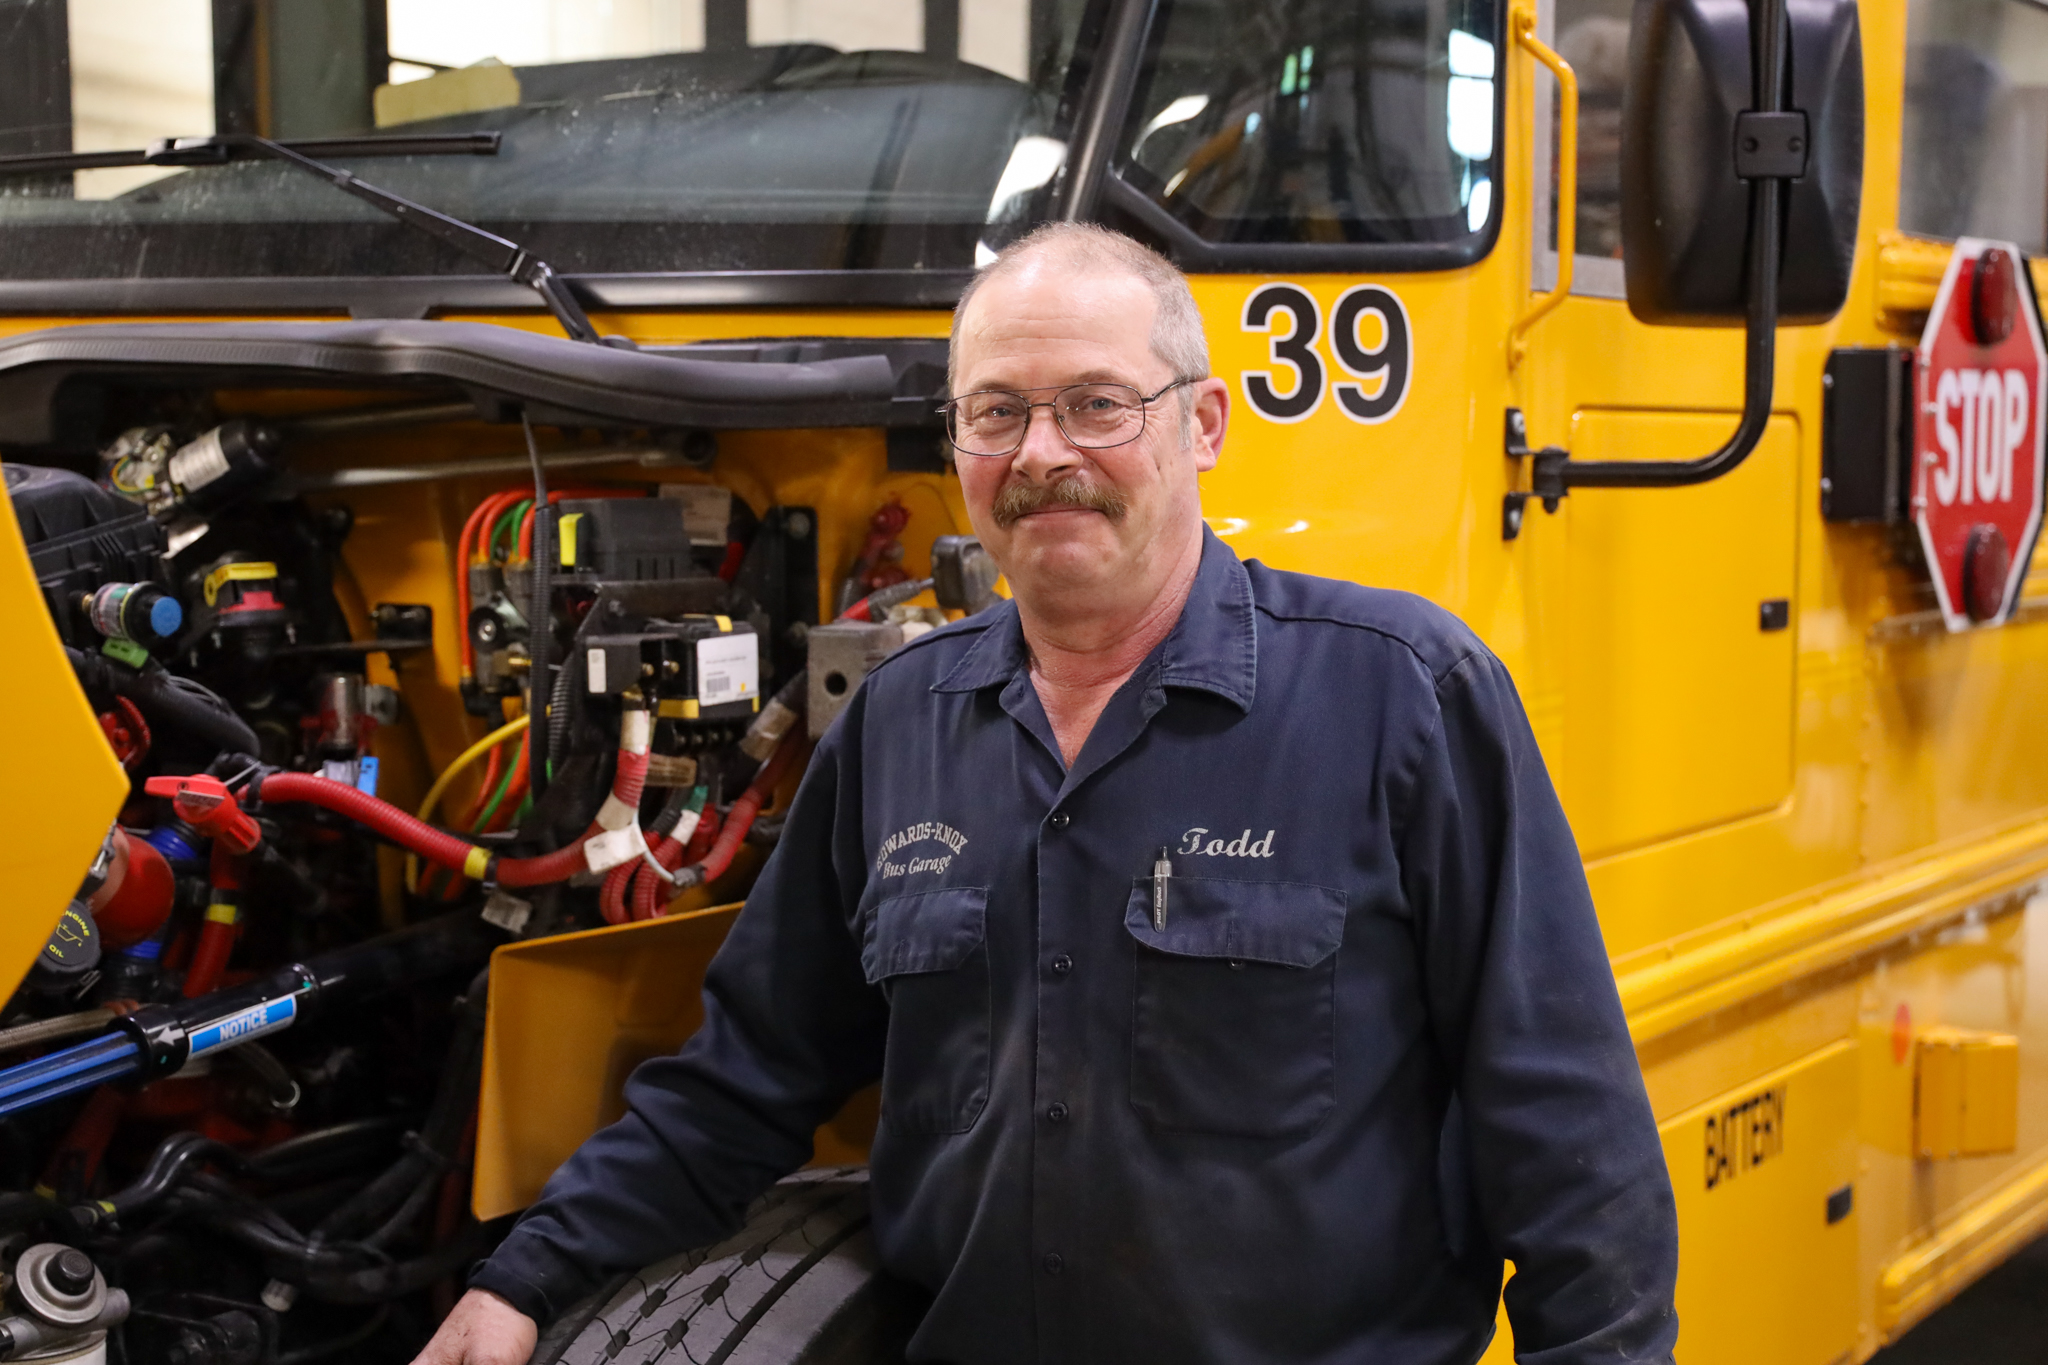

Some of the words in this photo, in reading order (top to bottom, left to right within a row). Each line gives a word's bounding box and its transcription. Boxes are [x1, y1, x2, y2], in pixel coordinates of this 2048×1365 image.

[1241, 282, 1413, 424] 39
[1934, 368, 2029, 506] STOP
[1177, 827, 1275, 858] Todd
[883, 861, 906, 880] Bus
[908, 855, 952, 875] Garage
[63, 909, 90, 936] NGINE
[49, 944, 64, 958] OIL
[220, 1008, 268, 1041] NOTICE
[1704, 1084, 1787, 1190] BATTERY
